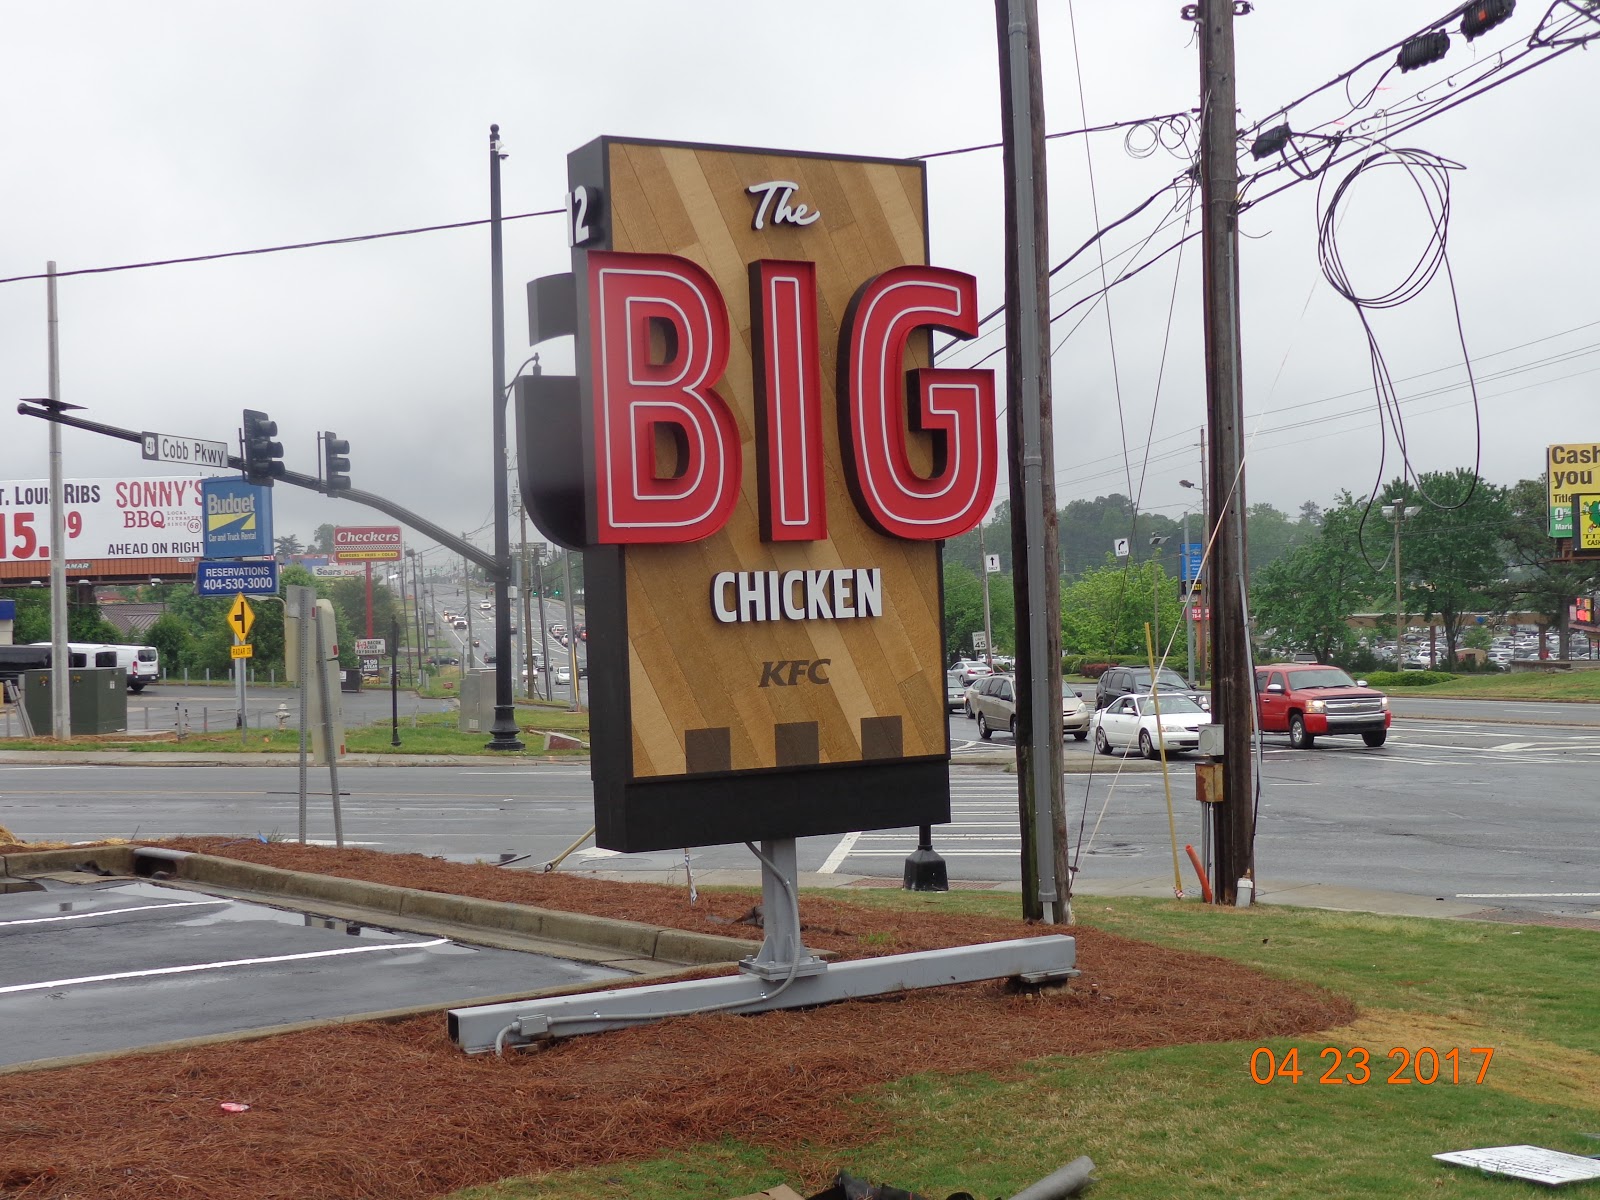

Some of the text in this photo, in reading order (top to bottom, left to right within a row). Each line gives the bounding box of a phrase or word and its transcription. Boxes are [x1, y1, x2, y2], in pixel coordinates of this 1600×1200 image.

[746, 180, 820, 230] The
[586, 250, 998, 545] BIG
[146, 438, 224, 467] 41 Cobb Pkwy
[1553, 470, 1593, 490] you
[15, 486, 52, 506] LOUI
[64, 483, 101, 504] RIBS
[207, 492, 256, 515] Budget
[123, 510, 166, 529] BBQ
[208, 531, 257, 542] Car and Truck Rental
[337, 531, 399, 543] Checkers
[107, 541, 203, 555] AHEAD ON RIGH
[205, 566, 270, 577] RESERVATIONS
[316, 568, 342, 576] Sears
[203, 577, 273, 590] 404-530-3000
[712, 567, 883, 623] CHICKEN
[758, 658, 832, 688] KFC
